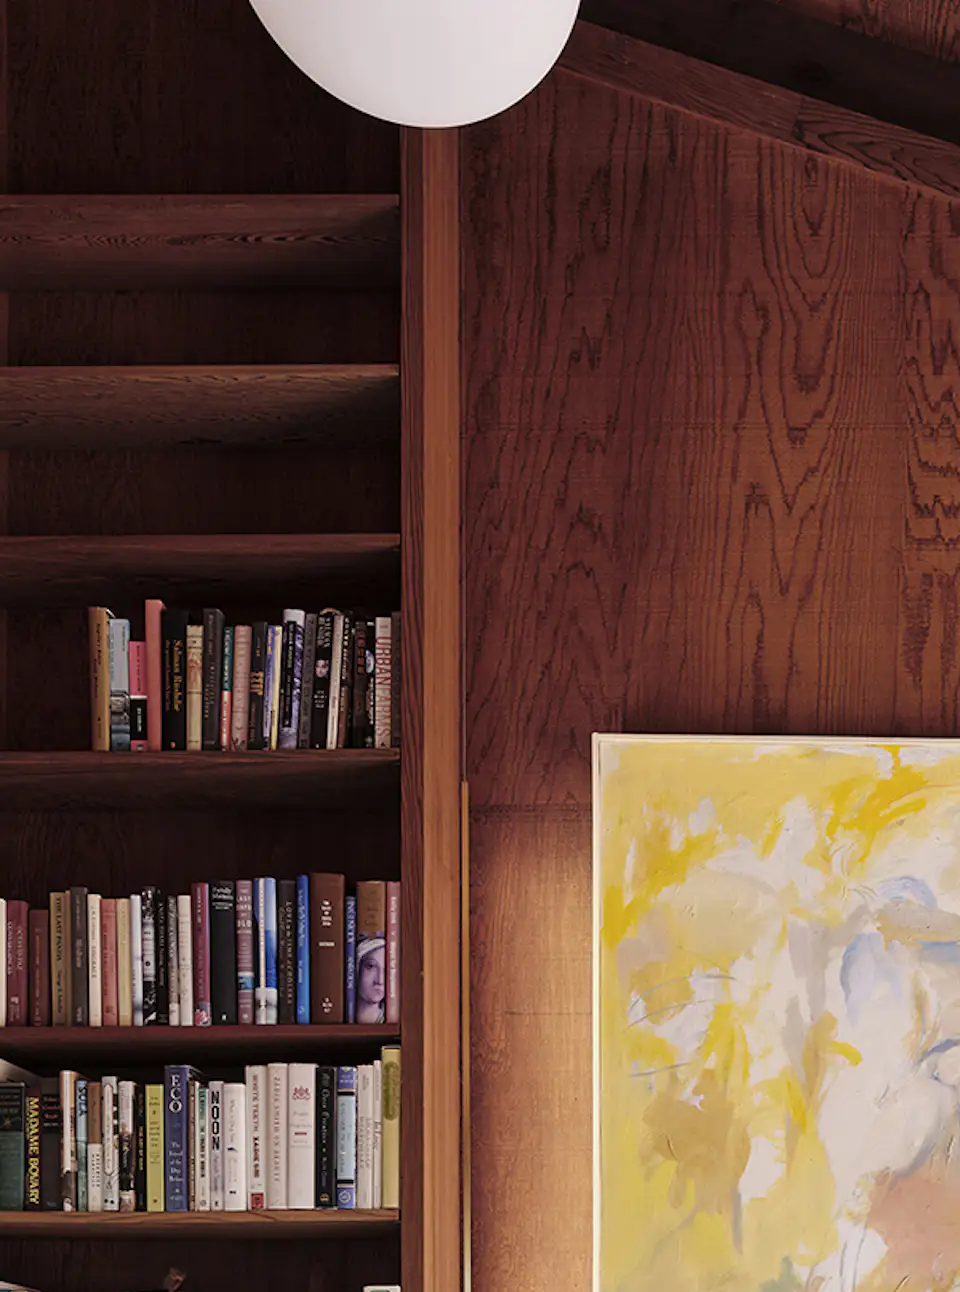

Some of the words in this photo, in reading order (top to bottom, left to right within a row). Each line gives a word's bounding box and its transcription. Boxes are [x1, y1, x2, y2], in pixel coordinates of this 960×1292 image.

[375, 636, 392, 685] URBAN
[375, 686, 392, 736] FARMS
[169, 1074, 183, 1113] ECO
[28, 1096, 40, 1155] MADAME
[211, 1091, 220, 1150] NOON
[28, 1156, 40, 1205] BOVARY
